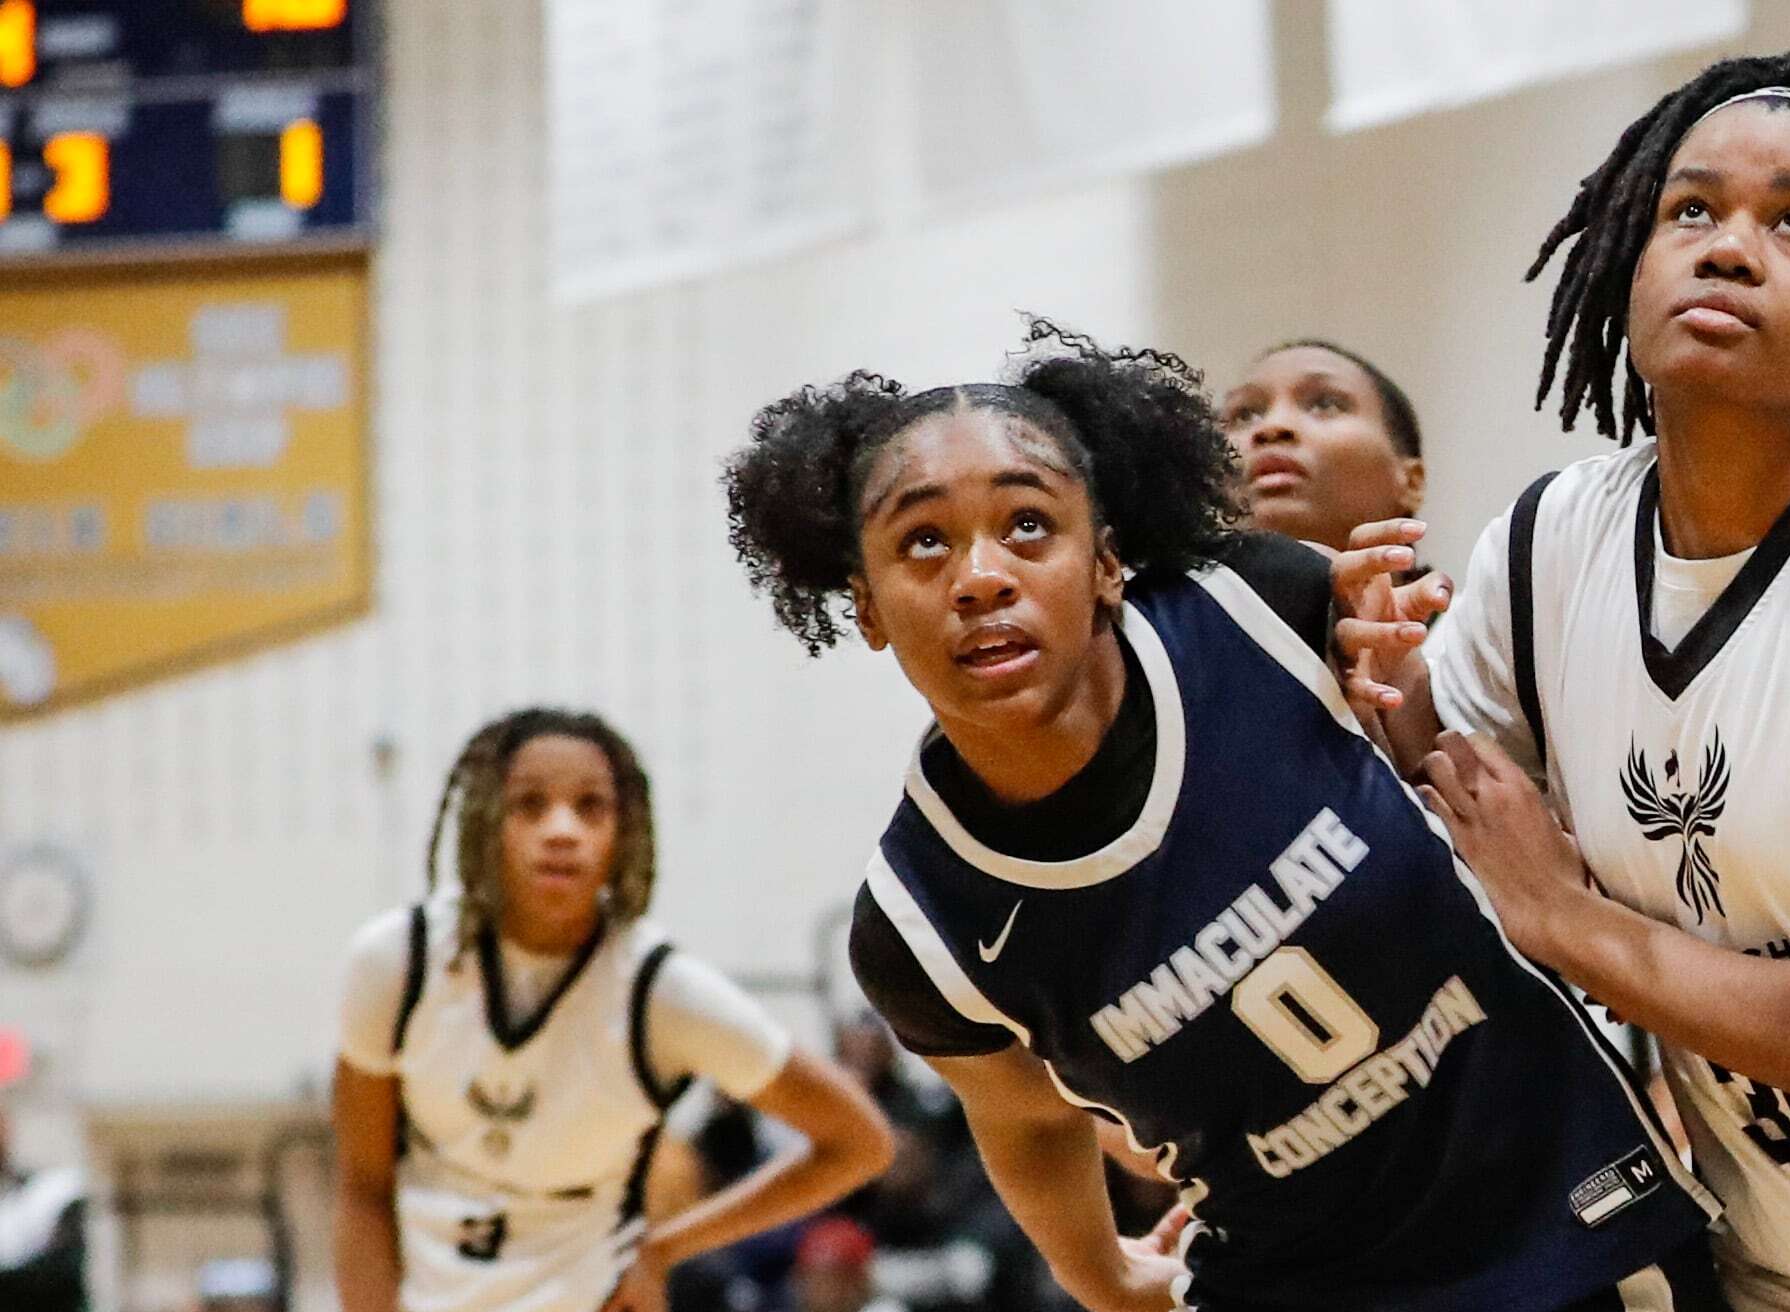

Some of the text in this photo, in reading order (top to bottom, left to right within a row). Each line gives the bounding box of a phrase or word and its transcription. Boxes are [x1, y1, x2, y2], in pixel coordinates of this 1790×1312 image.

[1089, 806, 1370, 1063] IMMACULATE
[1231, 946, 1380, 1084] 0
[1246, 975, 1488, 1178] CONCEPTION
[1630, 1159, 1654, 1184] M
